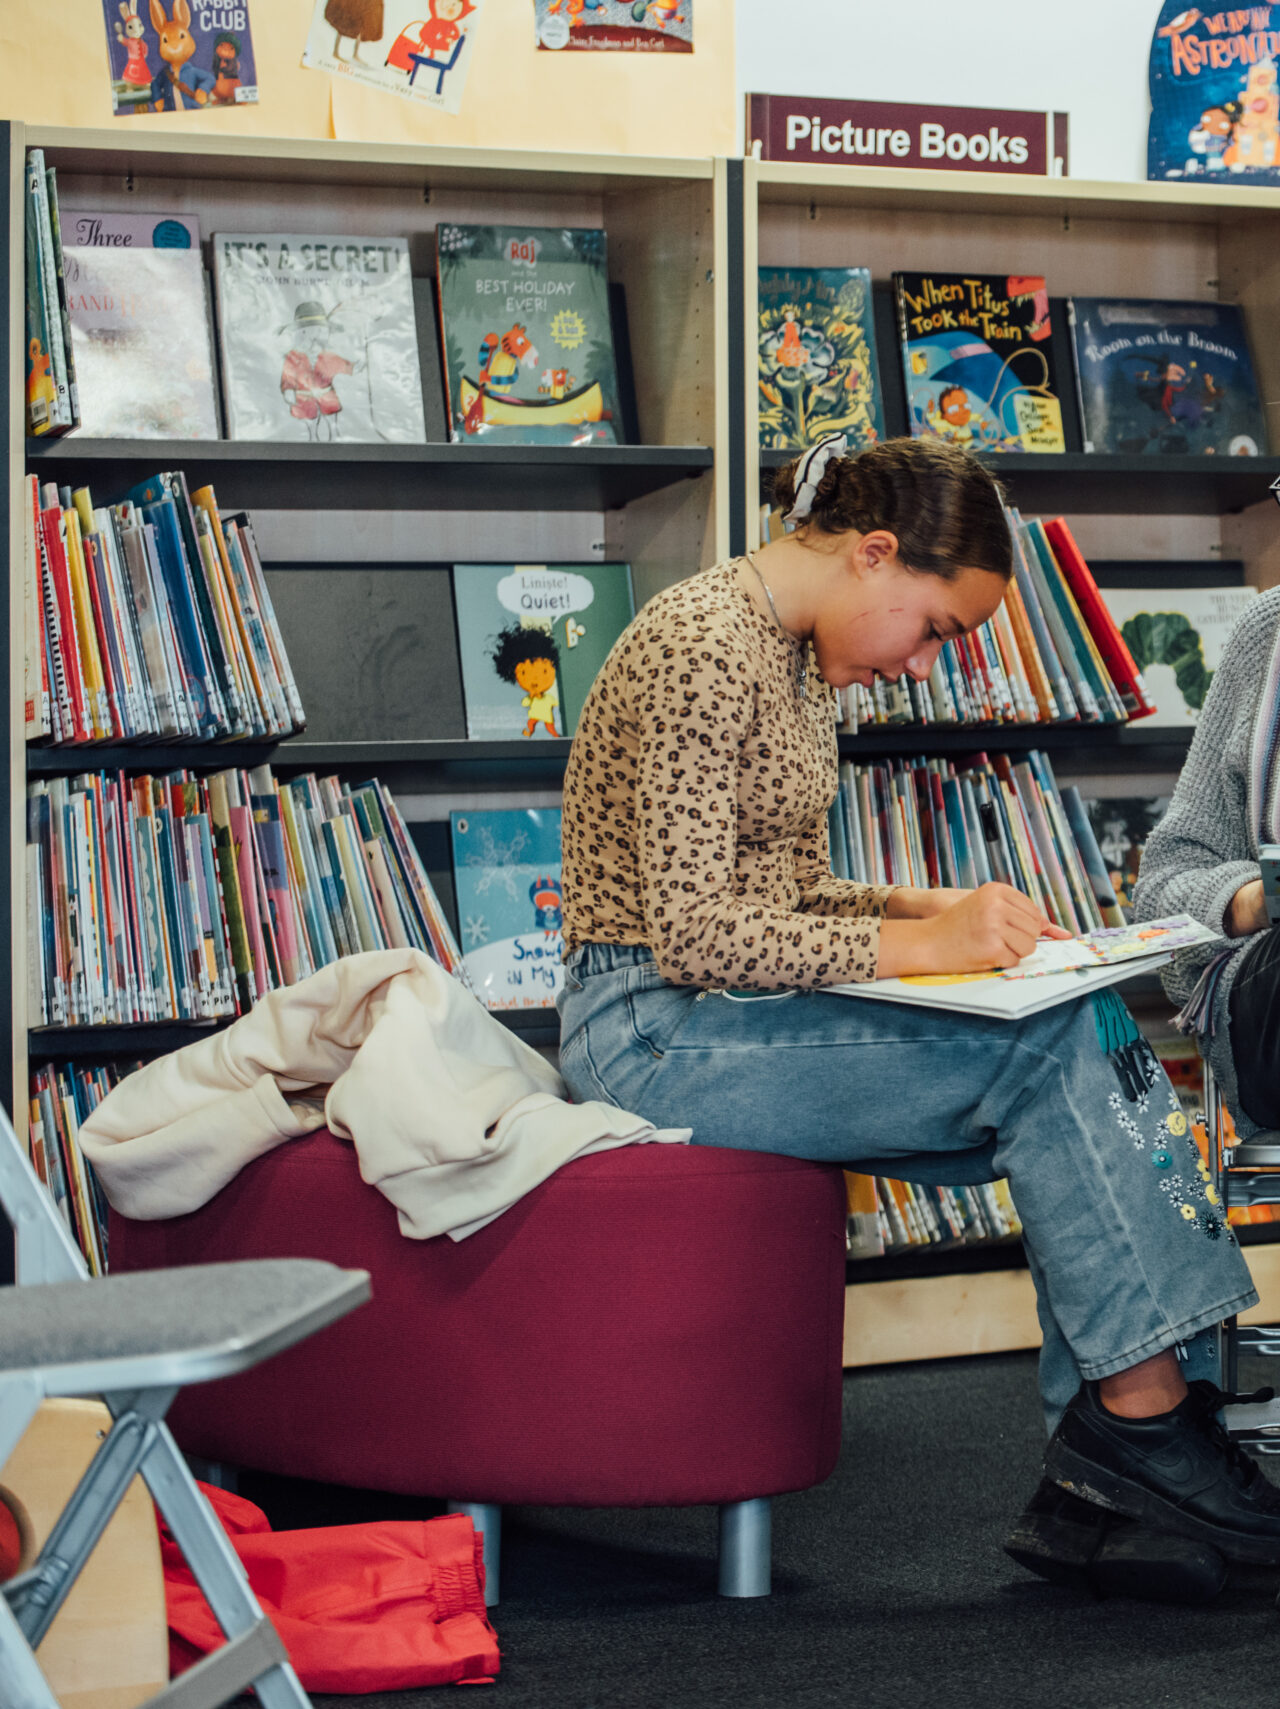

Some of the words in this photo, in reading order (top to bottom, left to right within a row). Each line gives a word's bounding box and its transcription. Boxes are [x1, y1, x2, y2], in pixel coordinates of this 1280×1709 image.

[200, 10, 246, 32] CLUB
[786, 114, 911, 158] Picture
[920, 122, 1029, 164] Books
[76, 218, 133, 246] Three
[223, 242, 269, 268] IT'S
[278, 243, 295, 270] A
[301, 244, 400, 273] SECRET!
[511, 239, 536, 264] Raj
[475, 279, 509, 294] BEST
[513, 280, 576, 295] HOLIDAY
[904, 278, 965, 314] When
[963, 279, 1010, 317] Titus
[506, 297, 548, 312] EVER!
[958, 308, 980, 328] the
[977, 312, 1023, 342] Train
[1084, 336, 1133, 362] Room
[1135, 334, 1157, 347] on
[1157, 330, 1183, 346] the
[1187, 331, 1239, 361] Broom
[520, 593, 571, 610] Quiet!
[531, 965, 556, 989] My
